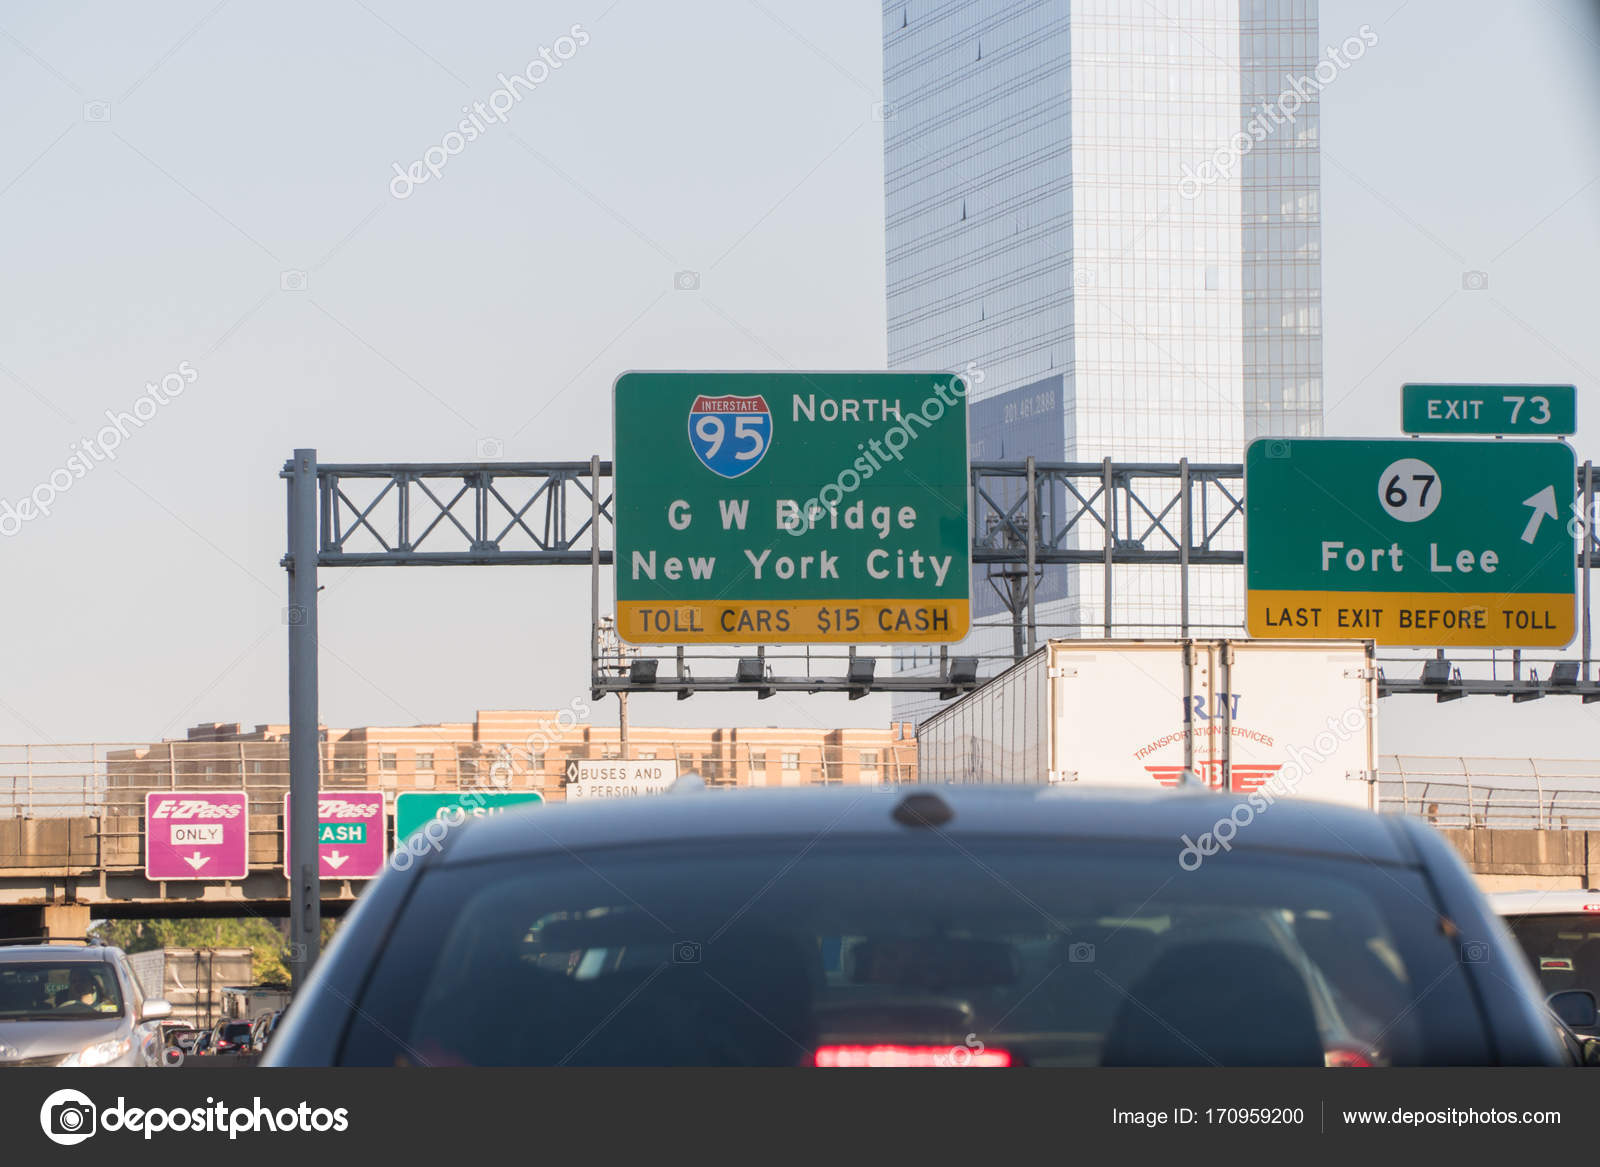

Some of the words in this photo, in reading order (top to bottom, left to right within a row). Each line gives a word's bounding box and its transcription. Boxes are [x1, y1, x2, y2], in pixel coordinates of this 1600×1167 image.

[702, 400, 759, 411] INTERSTATE
[792, 394, 901, 422] NORTH
[1427, 400, 1484, 419] EXIT
[1503, 396, 1551, 424] 73
[696, 416, 764, 460] 95
[1385, 474, 1435, 507] 67
[668, 500, 692, 531] G
[719, 500, 749, 531] W
[776, 500, 917, 540] Bridge
[631, 551, 715, 580] New
[744, 550, 840, 580] York
[866, 549, 953, 587] City
[1322, 541, 1403, 572] Fort
[1430, 543, 1499, 573] Lee
[639, 610, 704, 632] TOLL
[720, 609, 790, 631] CARS
[817, 608, 860, 634] $15
[878, 609, 948, 631] CASH
[1265, 608, 1322, 627] LAST
[1338, 609, 1383, 628] EXIT
[1400, 610, 1487, 629] BEFORE
[1502, 611, 1556, 630] TOLL
[1224, 726, 1274, 748] SERVICES
[581, 768, 626, 780] BUSES
[635, 768, 662, 780] AND
[576, 786, 583, 797] 3
[591, 786, 638, 798] PERSON
[175, 828, 218, 841] ONLY
[319, 826, 362, 841] ASH
